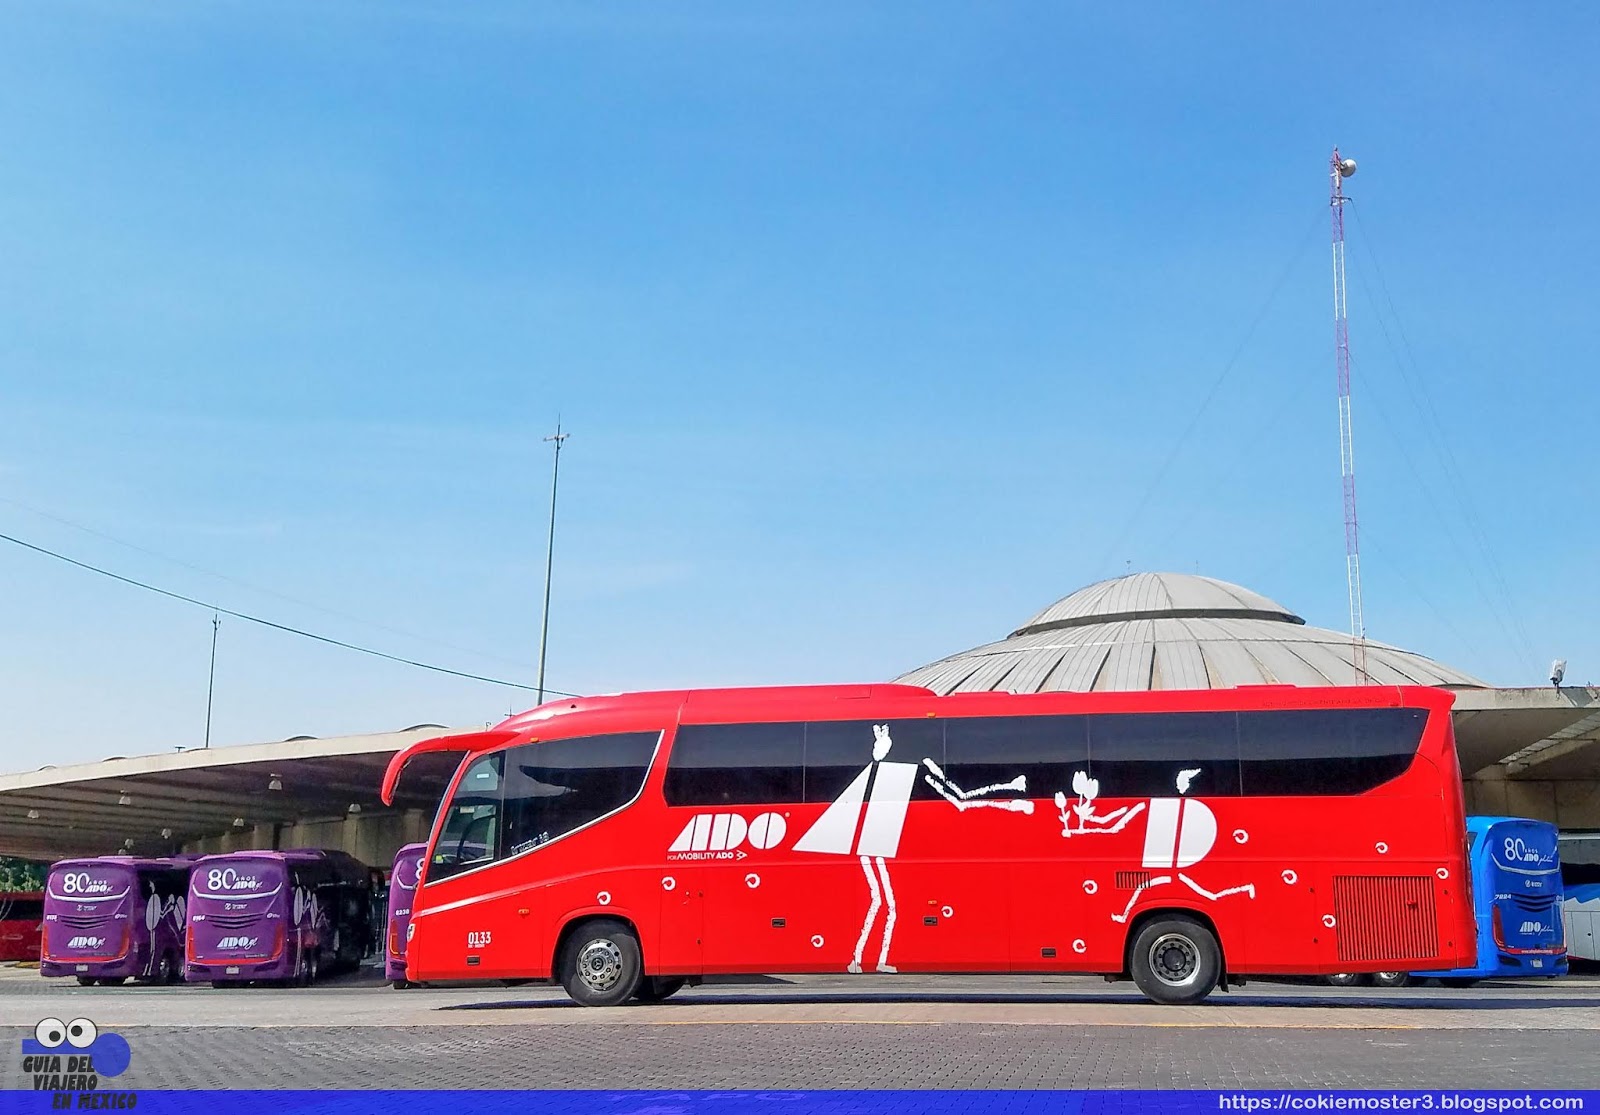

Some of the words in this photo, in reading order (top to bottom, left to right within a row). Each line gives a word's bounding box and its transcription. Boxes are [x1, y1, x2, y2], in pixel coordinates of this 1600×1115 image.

[667, 812, 787, 852] ADO
[1504, 837, 1525, 861] 80
[676, 852, 715, 860] MOBILITY
[716, 851, 734, 859] ADO
[1523, 853, 1539, 862] ADO
[63, 872, 90, 894] 80
[207, 867, 237, 891] 80
[231, 880, 256, 890] ADO
[85, 884, 107, 893] ADO
[1519, 921, 1541, 933] ADO
[67, 936, 97, 948] ADO
[217, 936, 248, 948] ADO
[468, 931, 492, 945] 0133
